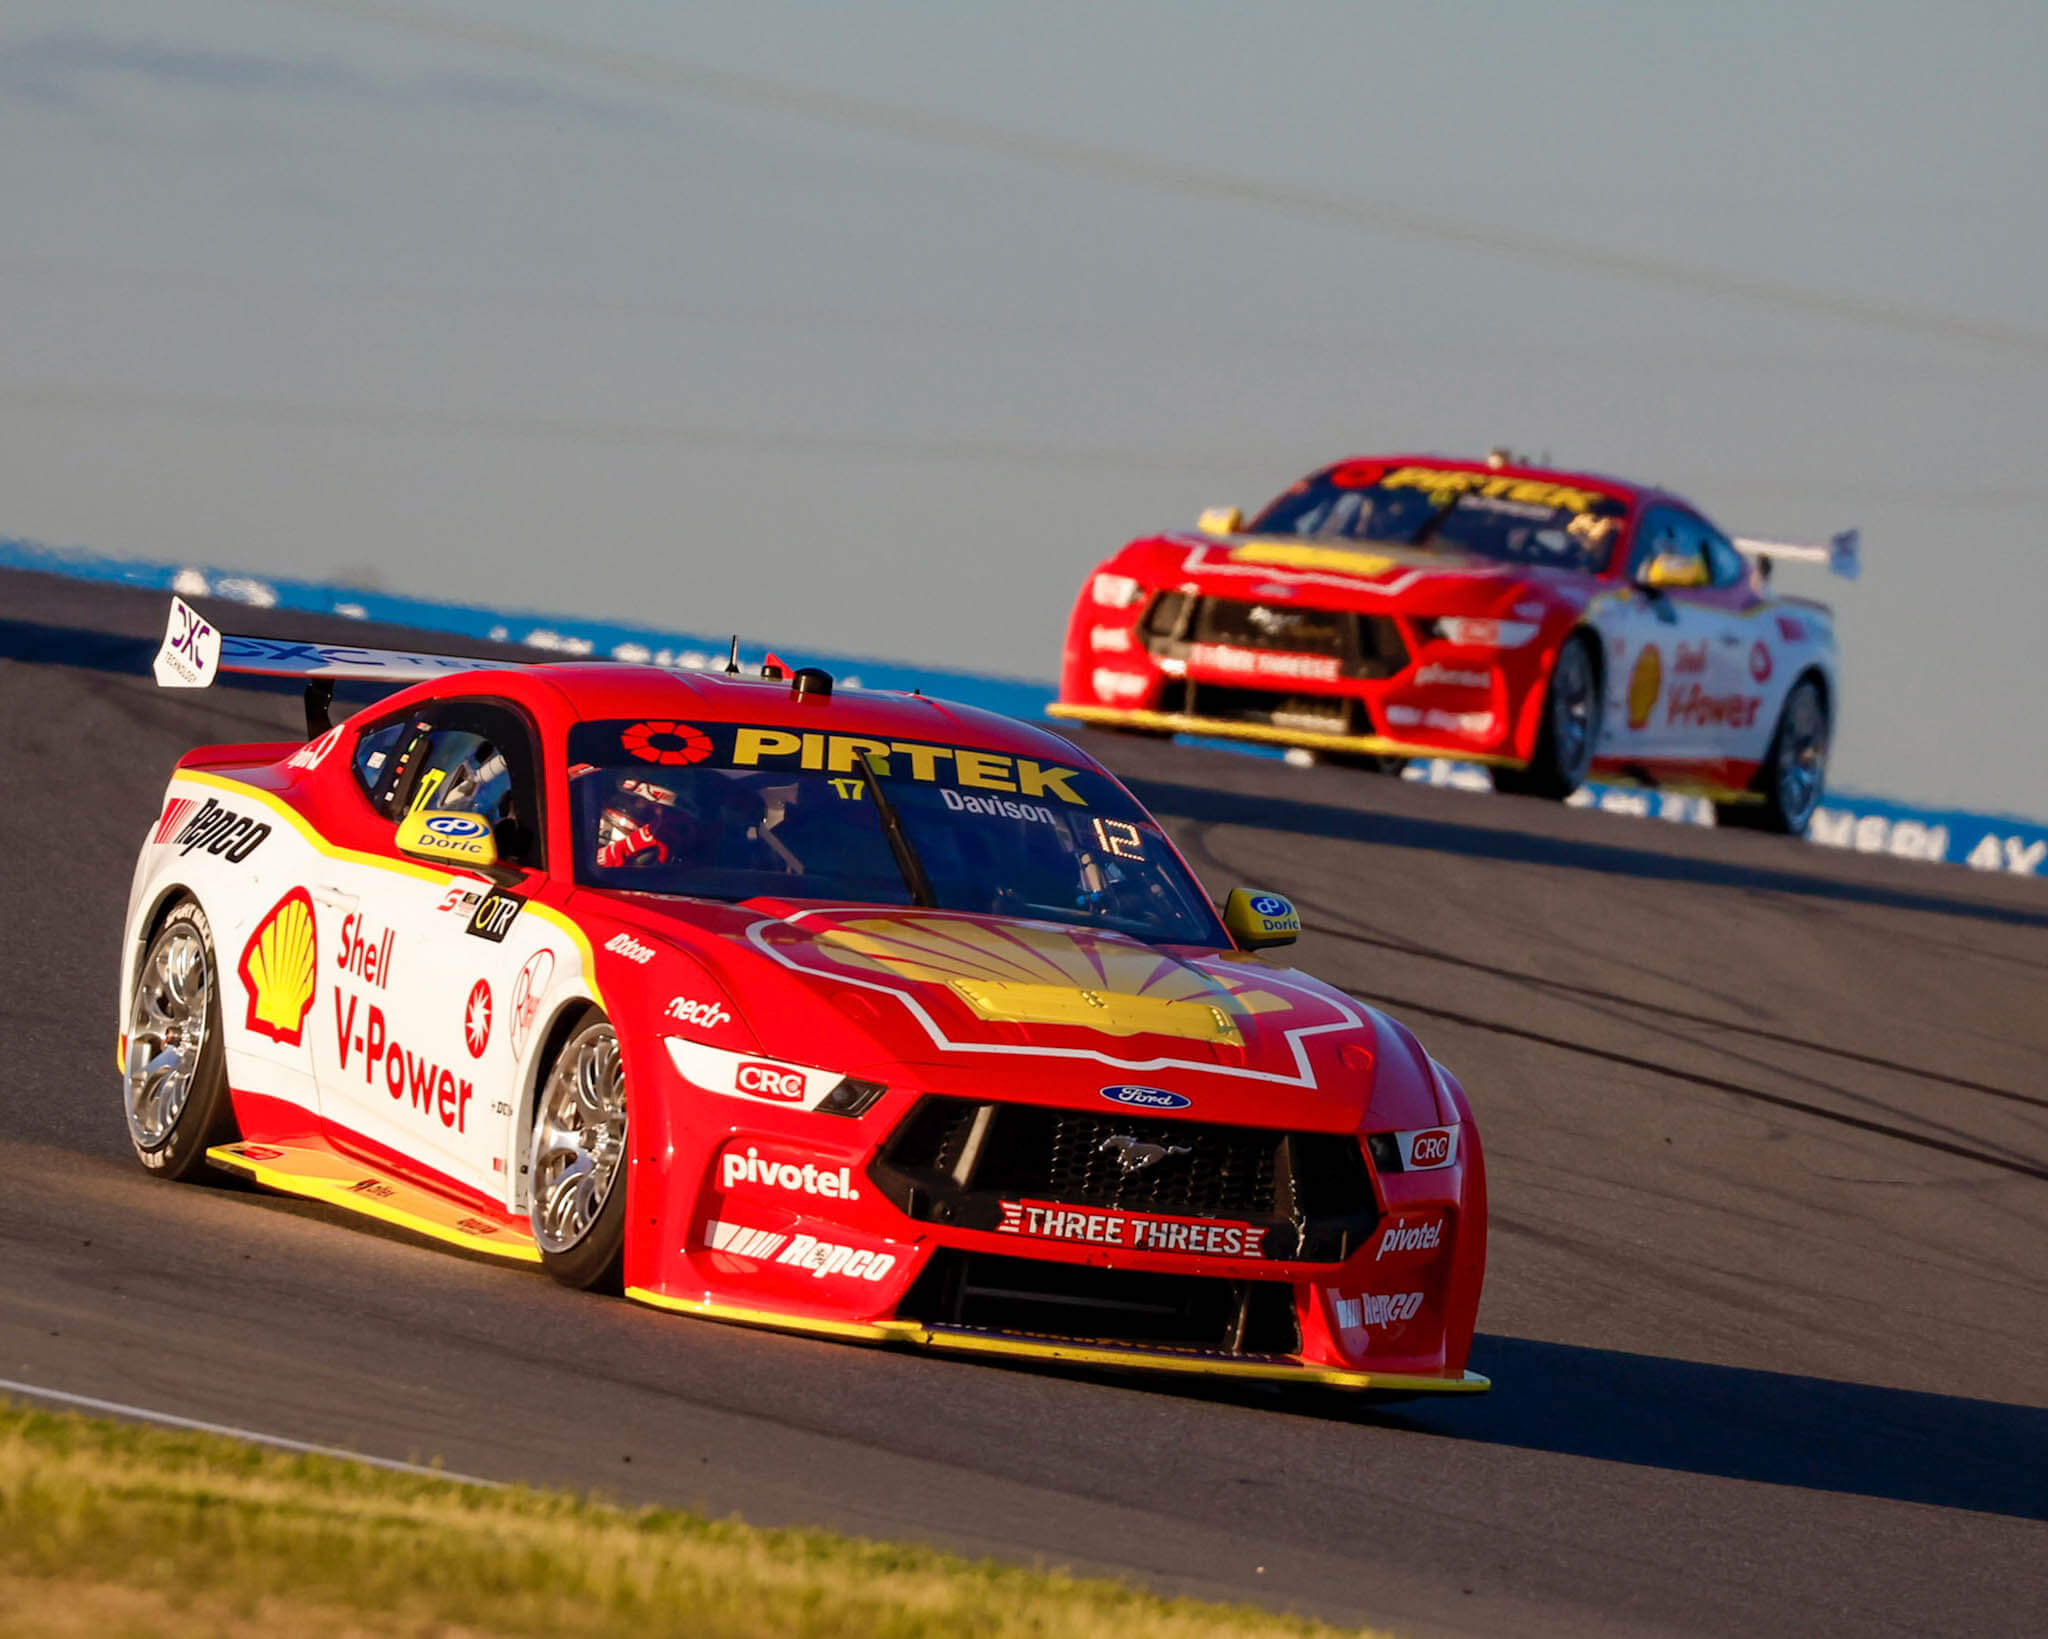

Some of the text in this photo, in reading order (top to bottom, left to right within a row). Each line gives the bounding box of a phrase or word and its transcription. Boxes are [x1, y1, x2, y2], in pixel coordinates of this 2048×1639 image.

[732, 728, 1088, 806] PIRTEK
[828, 777, 865, 800] 17
[939, 788, 1057, 826] Davison
[418, 834, 483, 854] Doric
[1092, 816, 1147, 862] 12
[475, 895, 520, 936] OTR
[1263, 918, 1299, 931] Doric
[337, 912, 396, 990] Shell
[334, 984, 473, 1134] V-Power
[739, 1066, 802, 1097] CRC
[1119, 1087, 1174, 1105] Ford
[1413, 1136, 1449, 1160] CRC
[1026, 1207, 1243, 1254] THREE THREES
[775, 1233, 897, 1282] Repco
